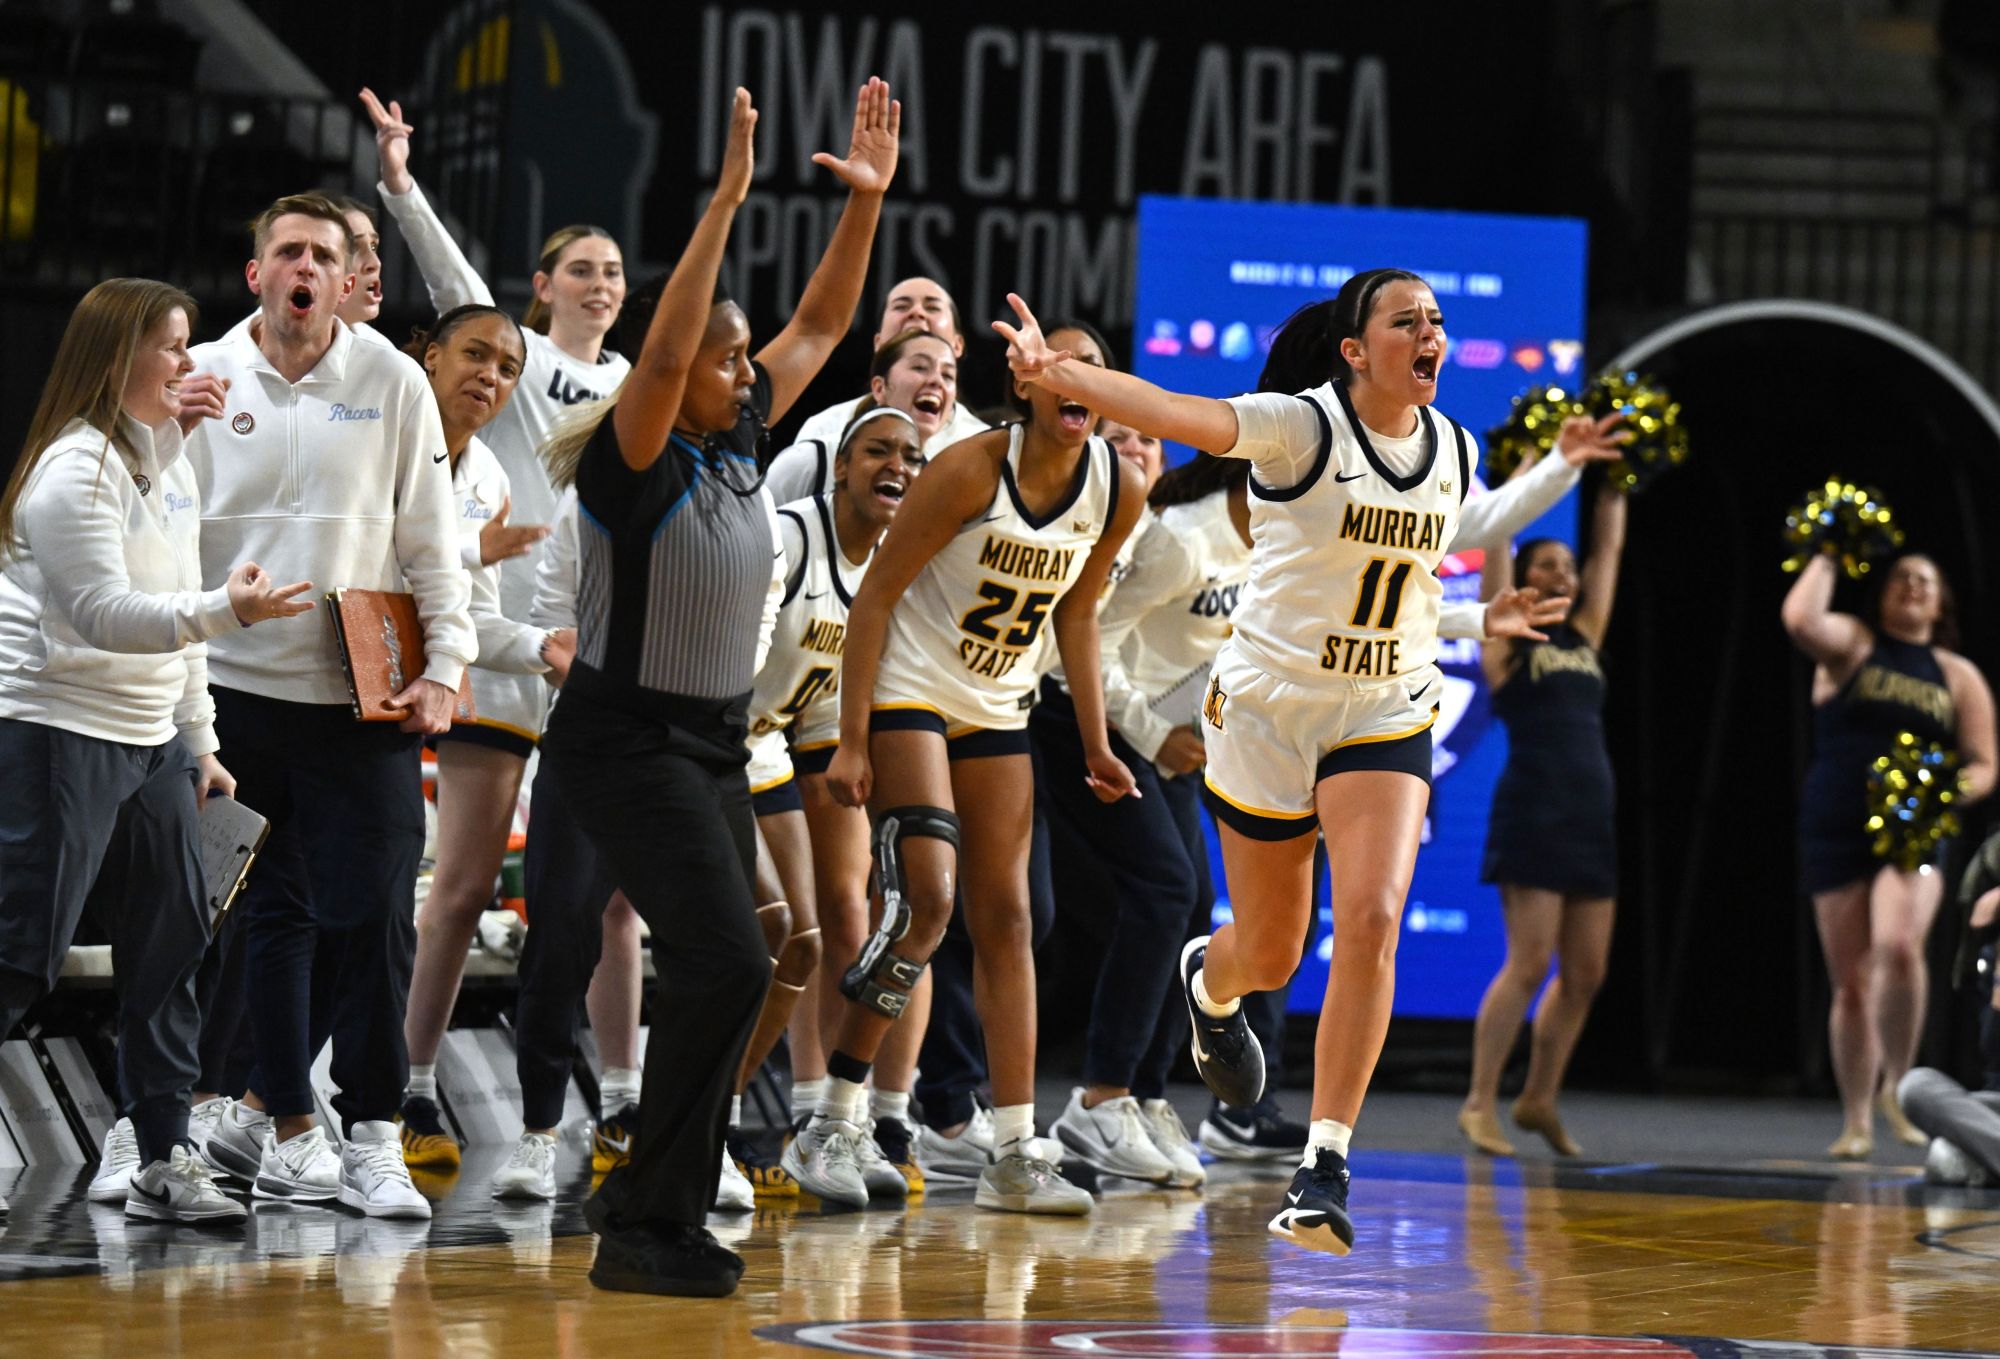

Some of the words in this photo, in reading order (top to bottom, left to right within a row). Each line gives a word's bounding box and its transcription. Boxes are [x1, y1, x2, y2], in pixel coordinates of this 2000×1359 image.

[696, 7, 928, 194] IOWA
[958, 25, 1160, 207] CITY
[1180, 44, 1391, 207] AREA
[971, 206, 1138, 338] COM
[328, 403, 381, 421] Racers
[1339, 502, 1446, 550] MURRAY
[978, 535, 1075, 581] MURRAY
[960, 578, 1060, 647] 25
[1348, 556, 1415, 630] 11
[800, 618, 845, 656] MUR
[1320, 633, 1400, 677] STATE
